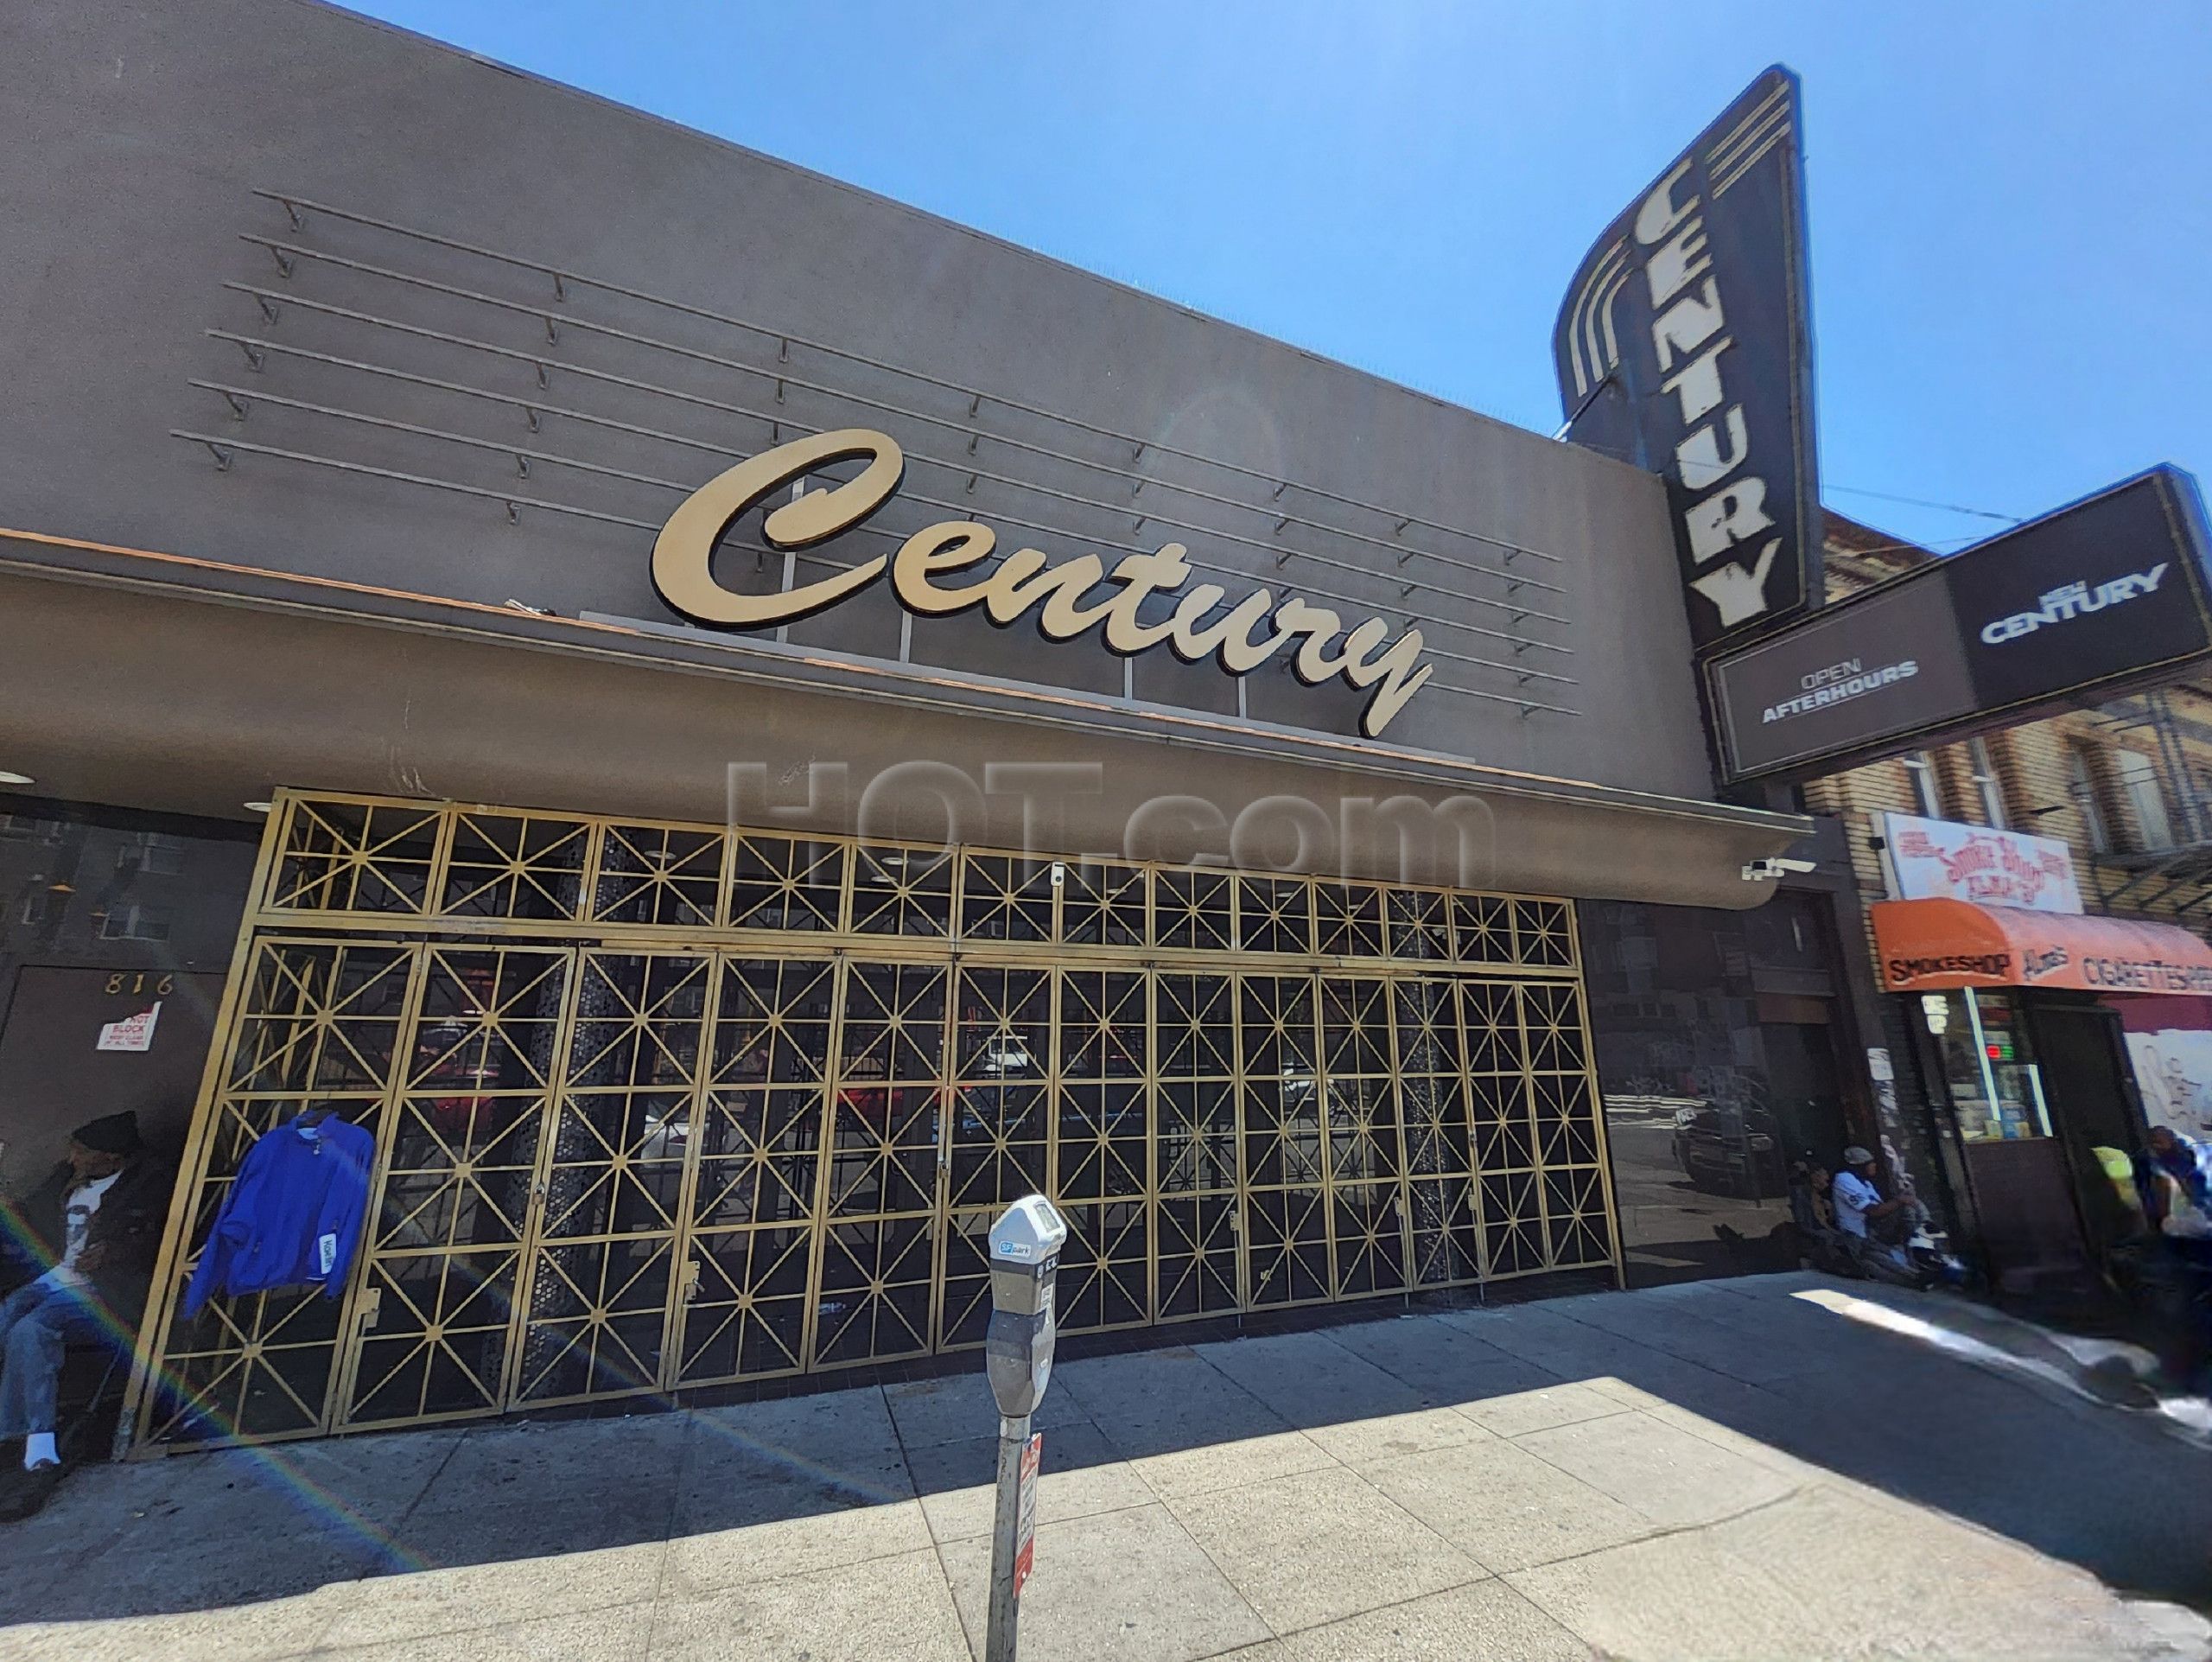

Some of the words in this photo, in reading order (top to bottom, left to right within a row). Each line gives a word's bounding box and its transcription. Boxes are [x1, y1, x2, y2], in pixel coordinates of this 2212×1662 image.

[1635, 156, 1783, 627] CENTURY
[650, 427, 1434, 740] Century
[1980, 562, 2169, 644] CENTURY
[1763, 660, 1919, 723] AFTERHOURS
[1801, 658, 1862, 690] OPEN
[105, 973, 173, 995] 816
